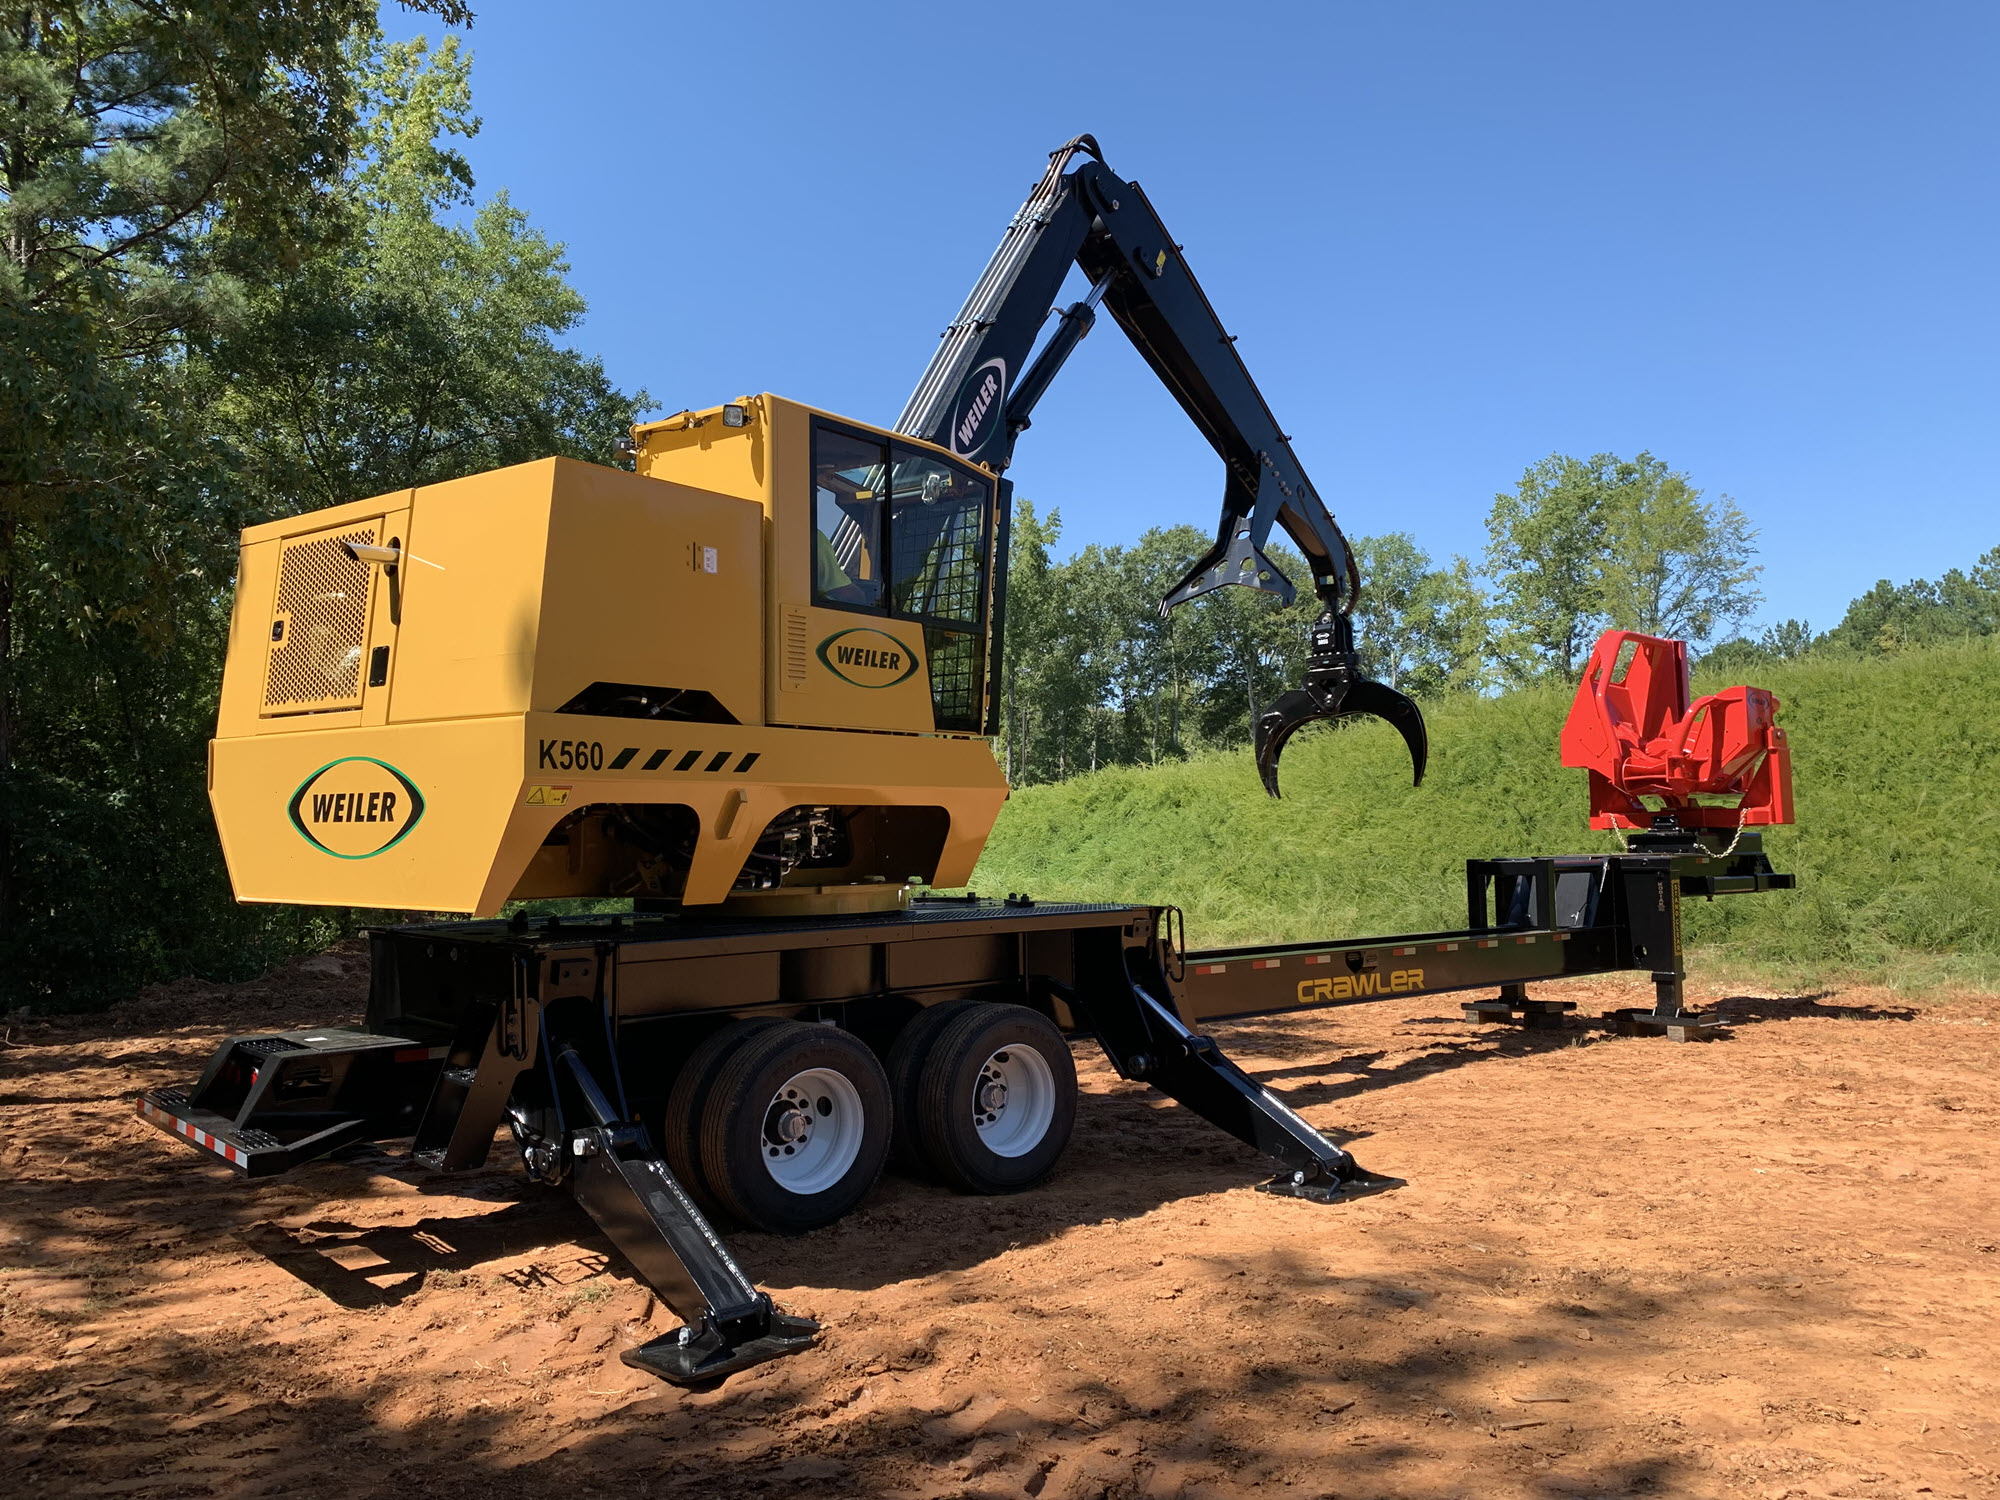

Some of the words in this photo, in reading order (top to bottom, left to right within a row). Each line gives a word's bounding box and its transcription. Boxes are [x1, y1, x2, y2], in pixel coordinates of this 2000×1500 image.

[958, 373, 998, 447] WEILER
[837, 645, 901, 670] WEILER
[539, 739, 604, 771] K560
[312, 791, 397, 823] WEILER
